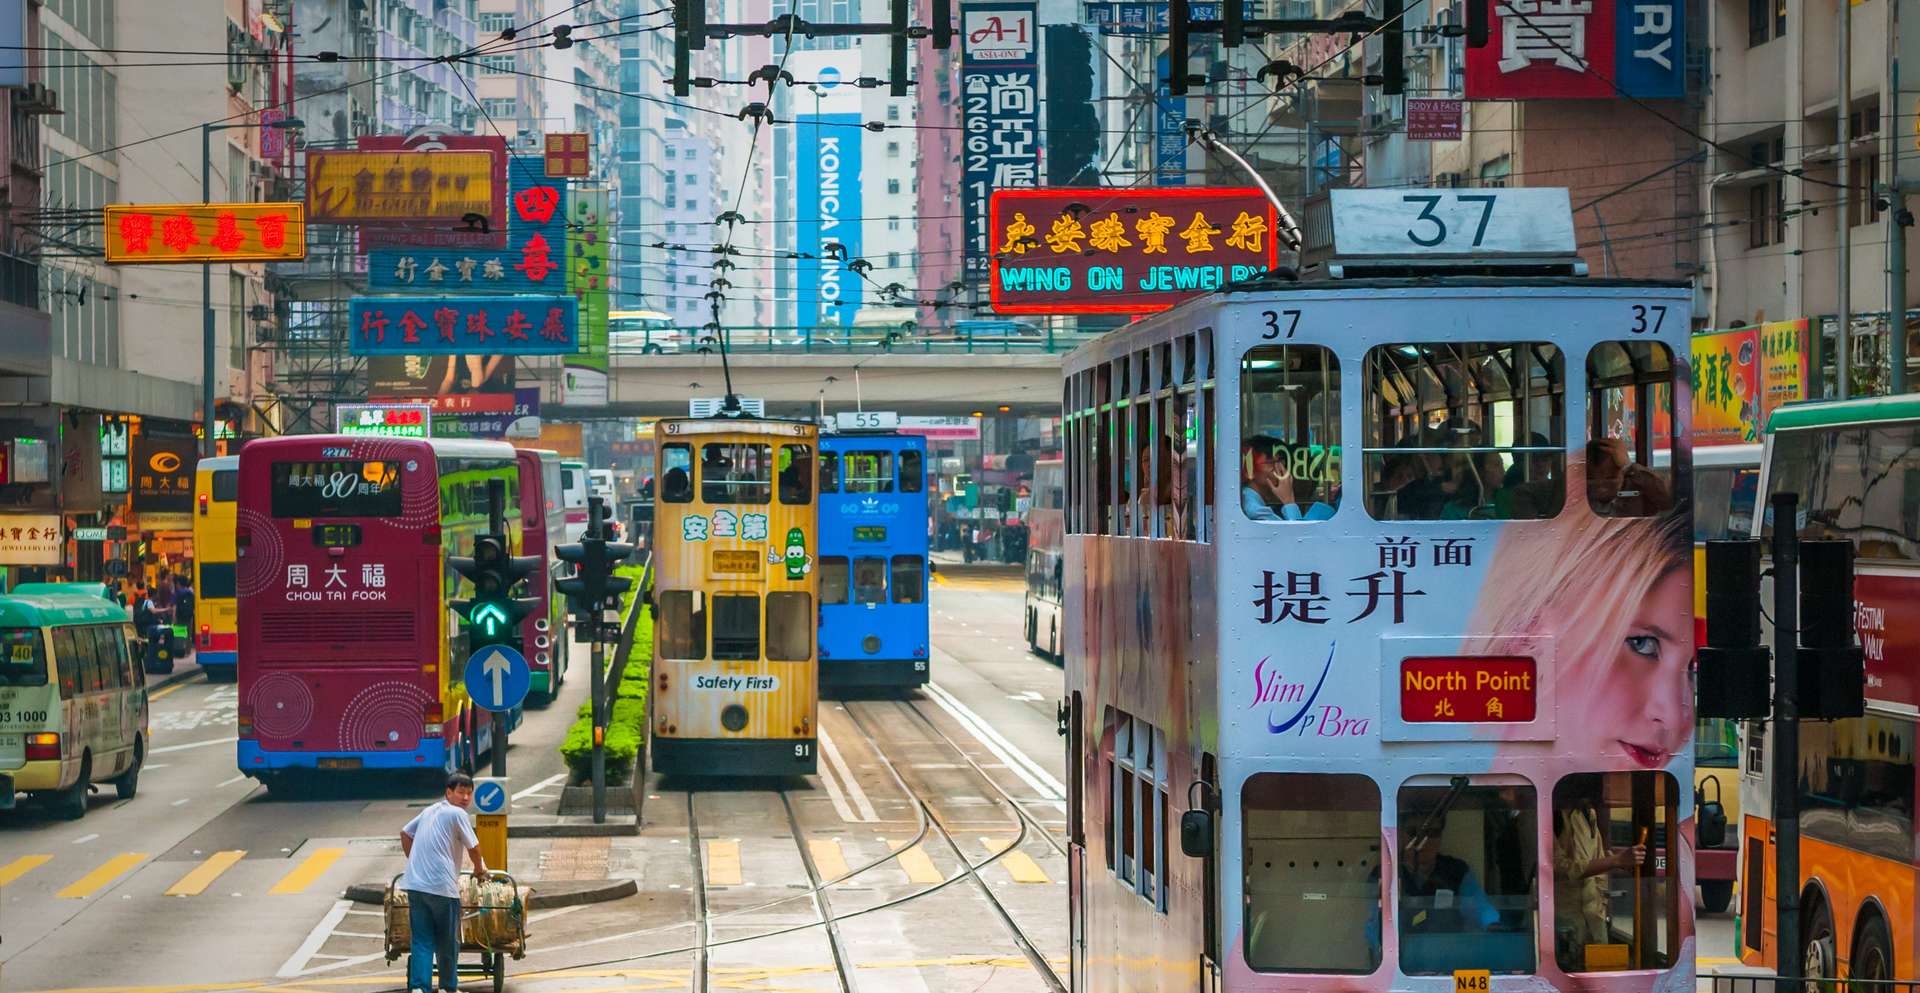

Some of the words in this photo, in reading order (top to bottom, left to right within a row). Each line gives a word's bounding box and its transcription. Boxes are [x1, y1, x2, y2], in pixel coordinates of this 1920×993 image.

[970, 17, 1029, 44] A-1
[1633, 5, 1673, 71] RY
[820, 137, 840, 231] KONICA
[1403, 195, 1496, 246] 37
[1001, 266, 1072, 291] WING
[1088, 266, 1123, 291] ON
[1261, 310, 1301, 339] 37
[1631, 305, 1667, 334] 37
[668, 424, 680, 433] 91
[793, 425, 806, 435] 91
[856, 413, 880, 426] 55
[322, 471, 358, 498] 80
[1375, 536, 1476, 567] 前面
[286, 563, 386, 588] 周大福
[286, 591, 322, 601] CHOW
[326, 591, 347, 601] TAI
[352, 591, 386, 601] FOOK
[1253, 570, 1427, 625] 提升
[1864, 633, 1884, 661] WALK
[697, 675, 741, 691] Safety
[746, 675, 773, 689] First
[1249, 655, 1304, 709] Slim
[1406, 671, 1467, 691] North
[1476, 671, 1530, 691] Point
[16, 711, 47, 722] 1000
[1434, 697, 1503, 718] 北角
[1317, 705, 1371, 737] Bra
[795, 744, 809, 757] 91
[1456, 976, 1489, 991] N48
